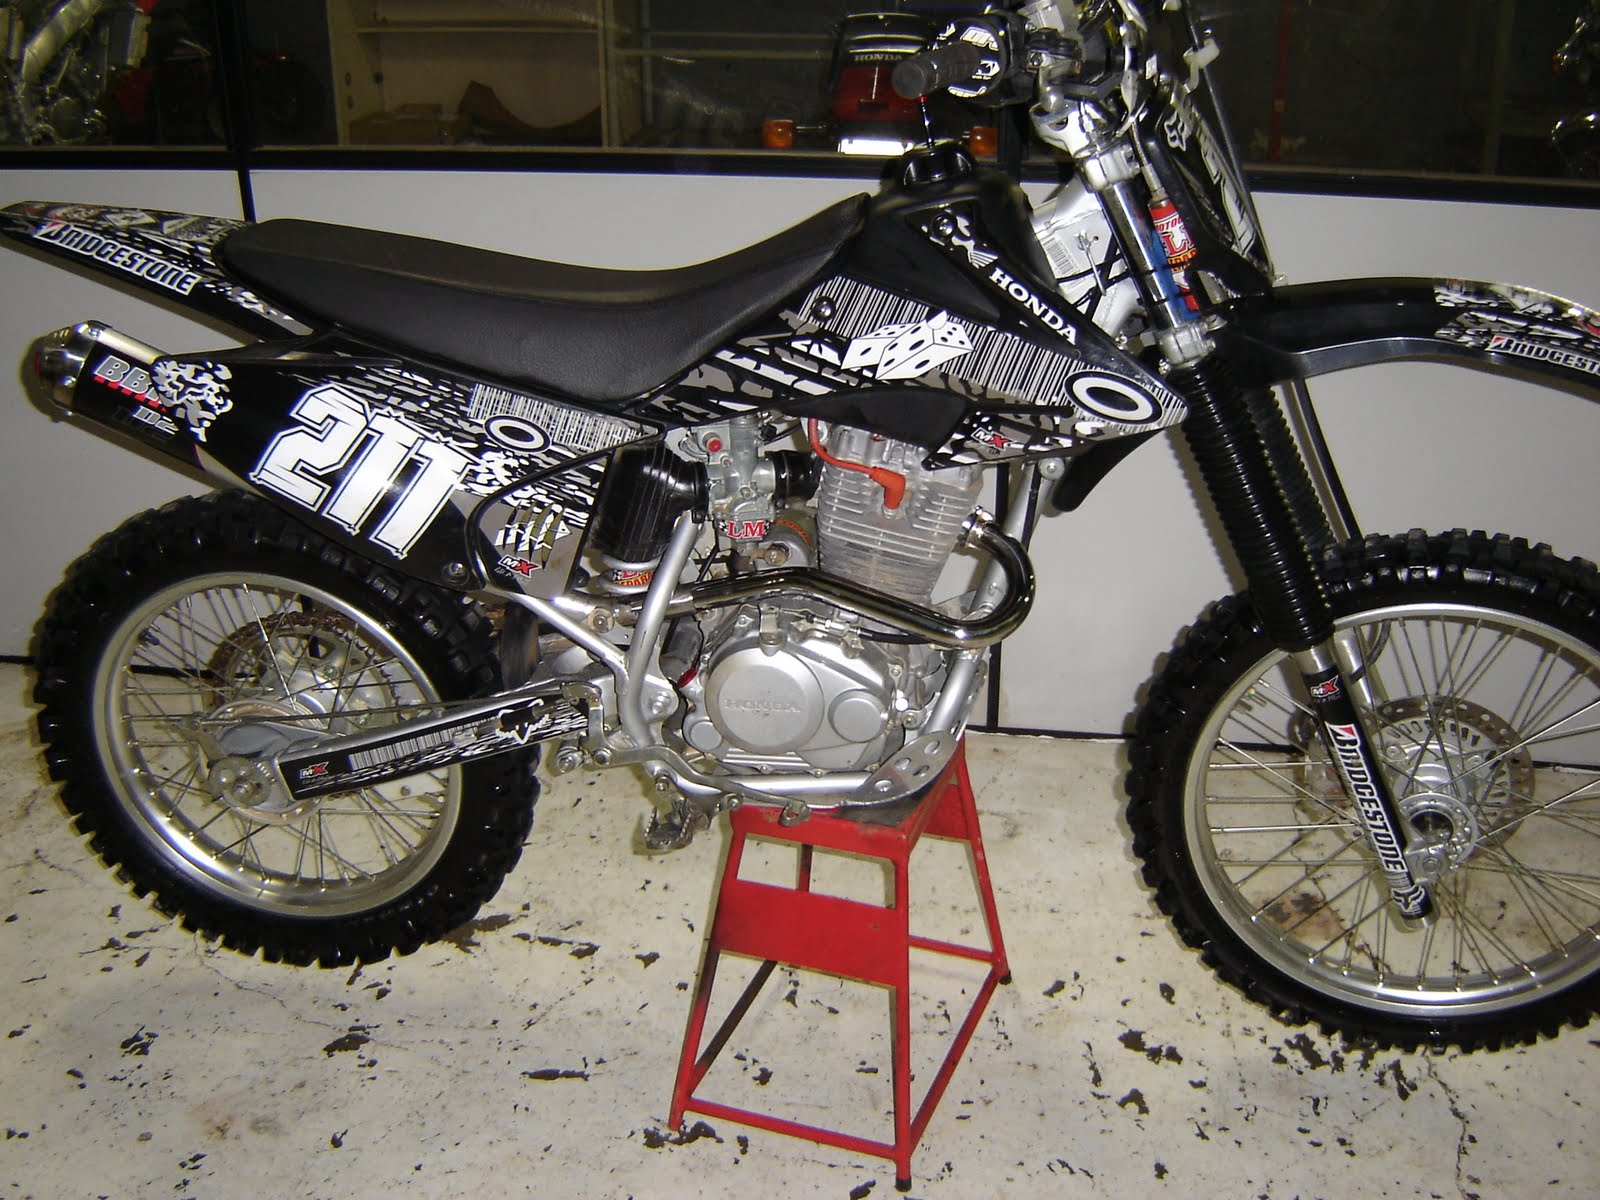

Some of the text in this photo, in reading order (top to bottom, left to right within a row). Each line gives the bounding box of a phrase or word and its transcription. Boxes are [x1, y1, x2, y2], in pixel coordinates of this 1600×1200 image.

[34, 221, 201, 296] BRIDGESTONE
[988, 267, 1077, 345] HONDA
[499, 555, 540, 578] MX
[727, 520, 766, 539] LM
[1324, 721, 1407, 873] BRIDGESTONE
